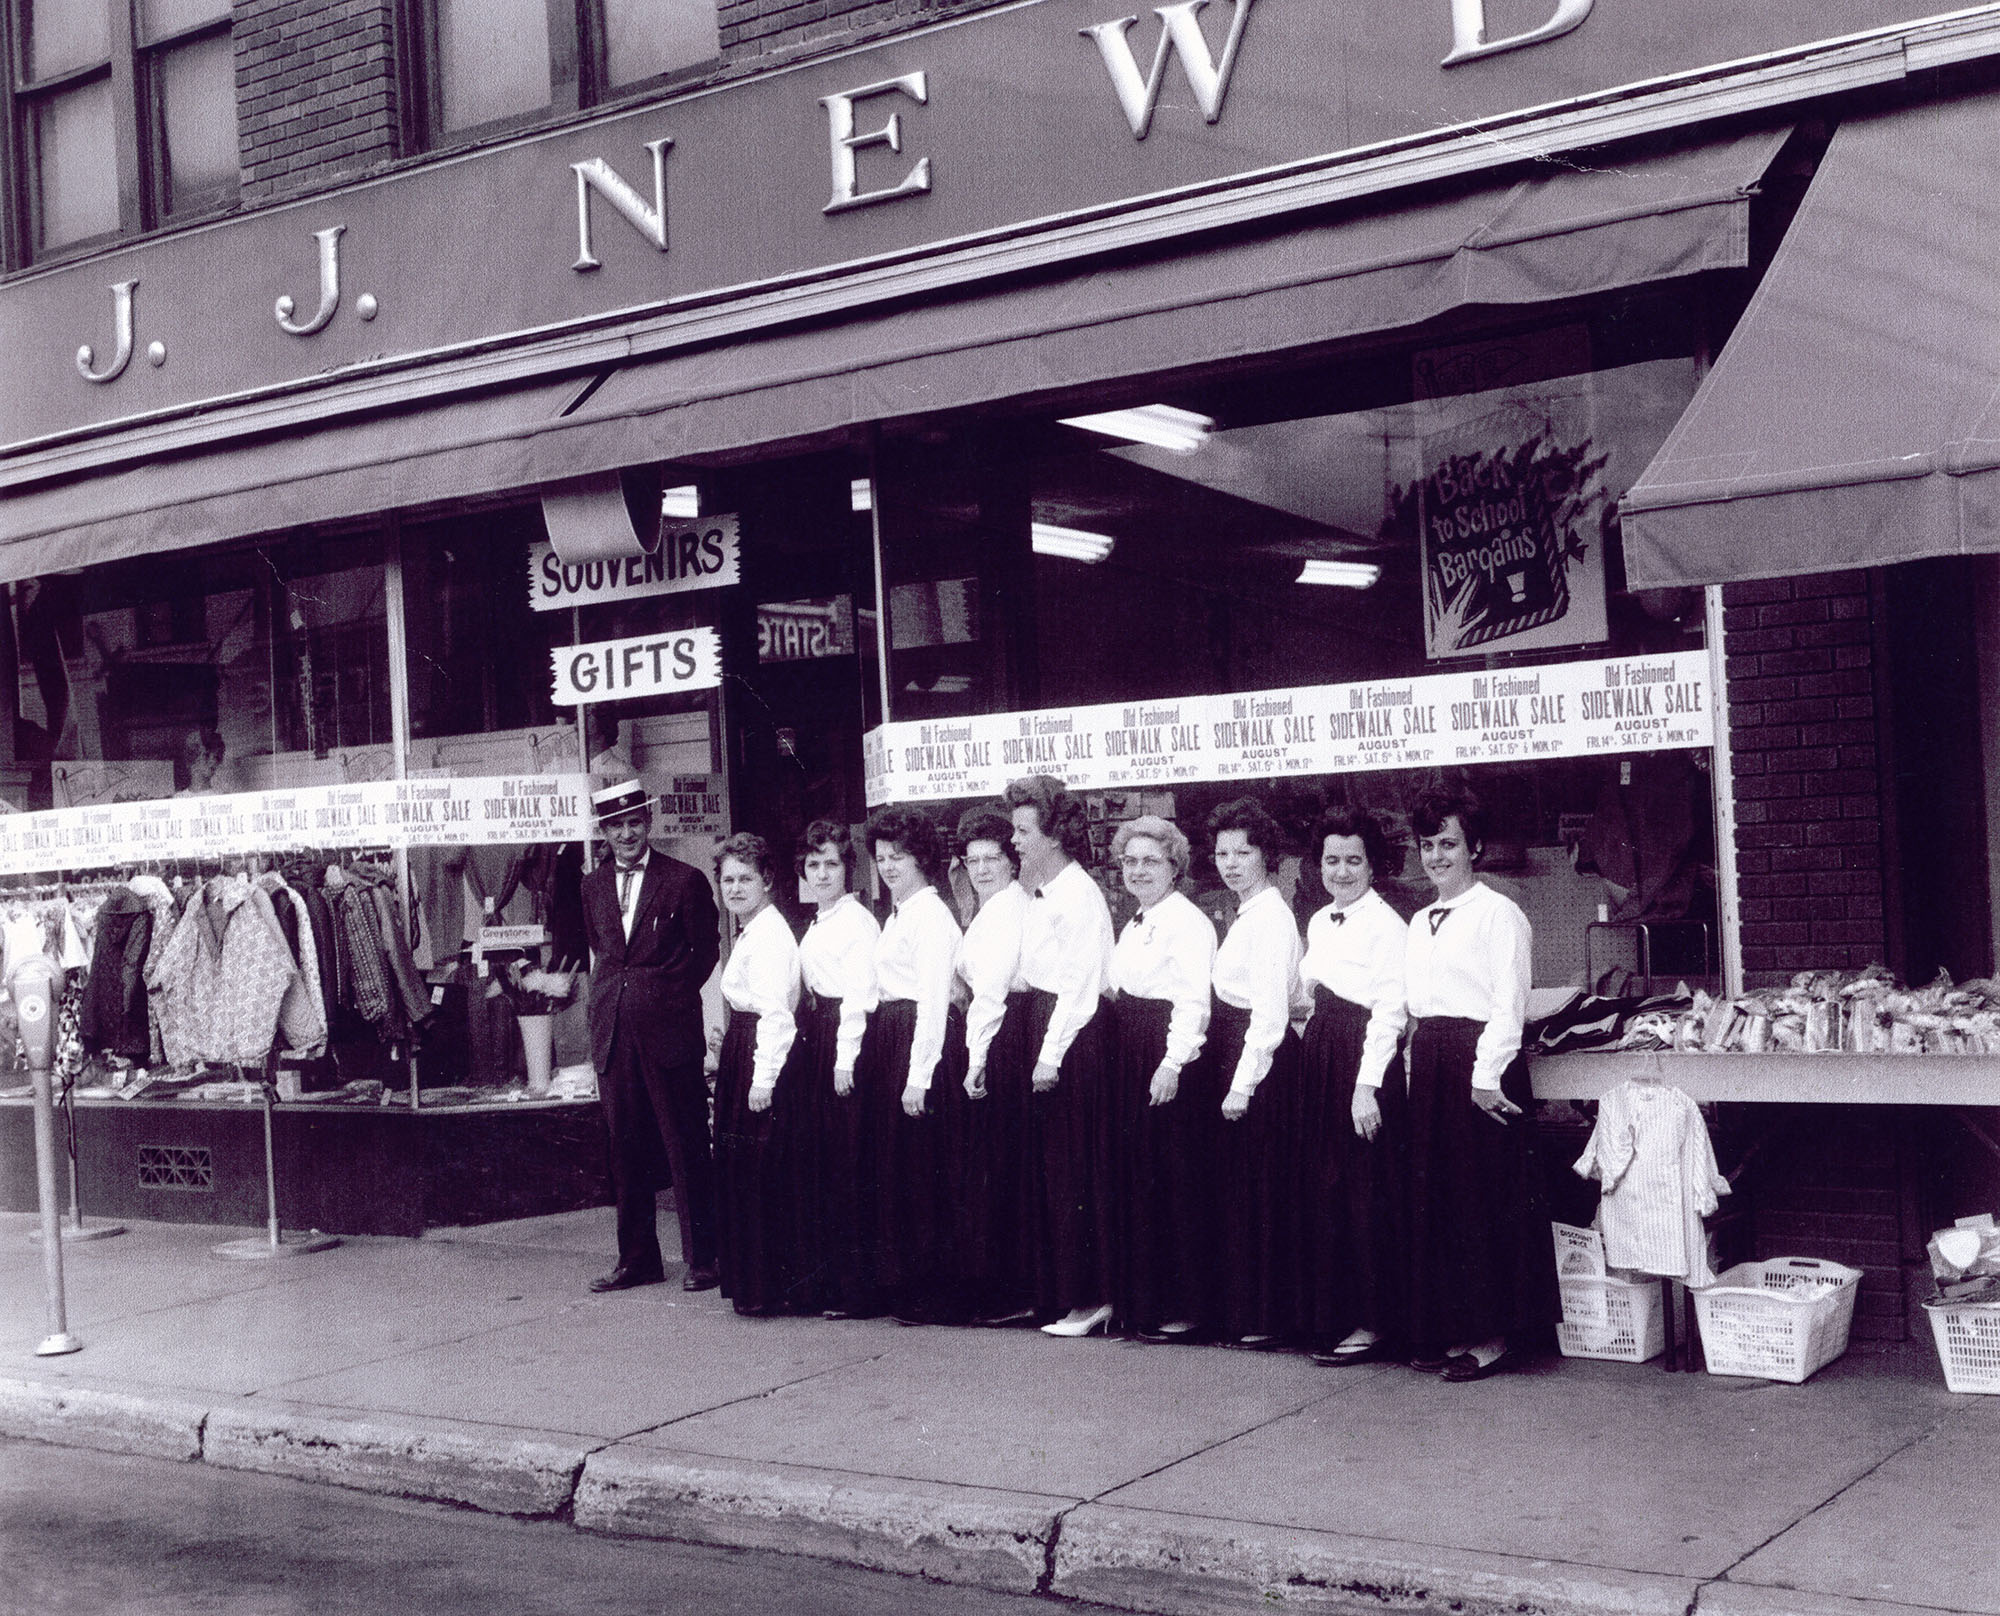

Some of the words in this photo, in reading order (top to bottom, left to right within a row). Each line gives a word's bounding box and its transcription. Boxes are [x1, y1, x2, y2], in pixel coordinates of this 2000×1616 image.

[77, 279, 166, 383] J.
[274, 225, 379, 336] J.
[1436, 458, 1512, 504] Back
[1432, 515, 1454, 543] to
[1455, 484, 1527, 538] School
[1438, 527, 1536, 588] Bargains
[569, 637, 698, 693] GIFTS
[1605, 665, 1620, 687] Old
[1625, 660, 1676, 686] Fashioned
[1350, 688, 1363, 710] Old
[1367, 684, 1412, 708] Fashioned
[1473, 677, 1488, 699] Old
[1492, 673, 1540, 697] Fashioned
[1233, 699, 1247, 720] Old
[1250, 695, 1293, 718] Fashioned
[1451, 699, 1519, 731] SIDEWALK
[1531, 694, 1566, 725] SALE
[1581, 686, 1653, 720] SIDEWALK
[1665, 682, 1703, 714] SALE
[1020, 717, 1031, 736] Old
[1034, 713, 1073, 735] Fashioned
[1123, 708, 1136, 728] Old
[1139, 704, 1180, 727] Fashioned
[1330, 708, 1393, 740] SIDEWALK
[1403, 705, 1437, 735] SALE
[1615, 718, 1670, 731] AUGUST
[920, 726, 931, 744] Old
[934, 722, 972, 743] Fashioned
[1105, 727, 1162, 757] SIDEWALK
[1171, 724, 1201, 752] SALE
[1213, 719, 1274, 749] SIDEWALK
[1284, 715, 1316, 744] SALE
[1358, 738, 1408, 751] AUGUST
[1481, 729, 1535, 742] AUGUST
[905, 744, 956, 772] SIDEWALK
[964, 741, 992, 768] SALE
[1003, 736, 1057, 765] SIDEWALK
[1065, 732, 1094, 760] SALE
[1241, 748, 1288, 760] AUGUST
[1027, 764, 1068, 774] AUGUST
[1131, 756, 1175, 767] AUGUST
[503, 781, 515, 796] Old
[519, 779, 558, 795] Fashioned
[928, 771, 969, 782] AUGUST
[358, 804, 377, 826] SALE
[443, 799, 471, 822] SALE
[483, 797, 542, 820] SIDEWALK
[550, 796, 578, 817] SALE
[509, 820, 553, 828] AUGUST
